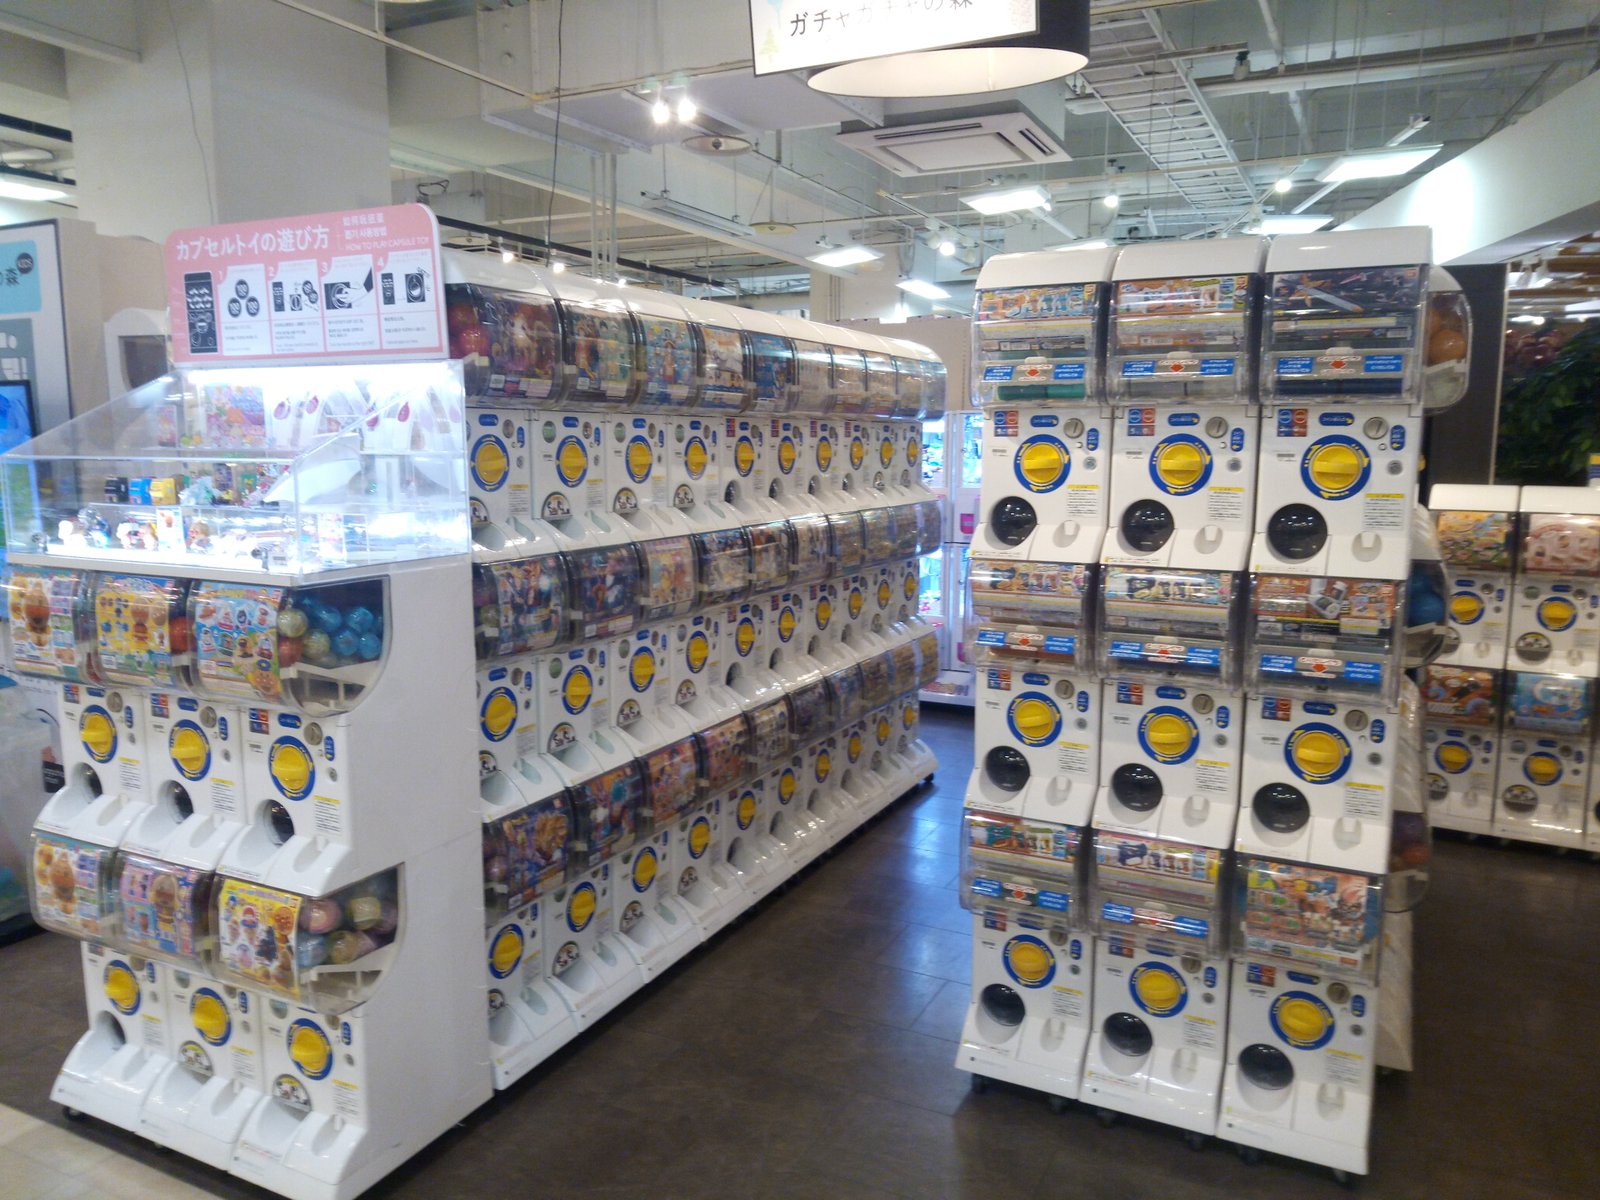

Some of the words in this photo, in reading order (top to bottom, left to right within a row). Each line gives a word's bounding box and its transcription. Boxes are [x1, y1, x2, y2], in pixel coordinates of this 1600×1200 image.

[177, 225, 329, 260] カプセルトイの遊び方
[321, 262, 328, 273] 3
[377, 257, 385, 268] 4
[268, 266, 276, 277] 2
